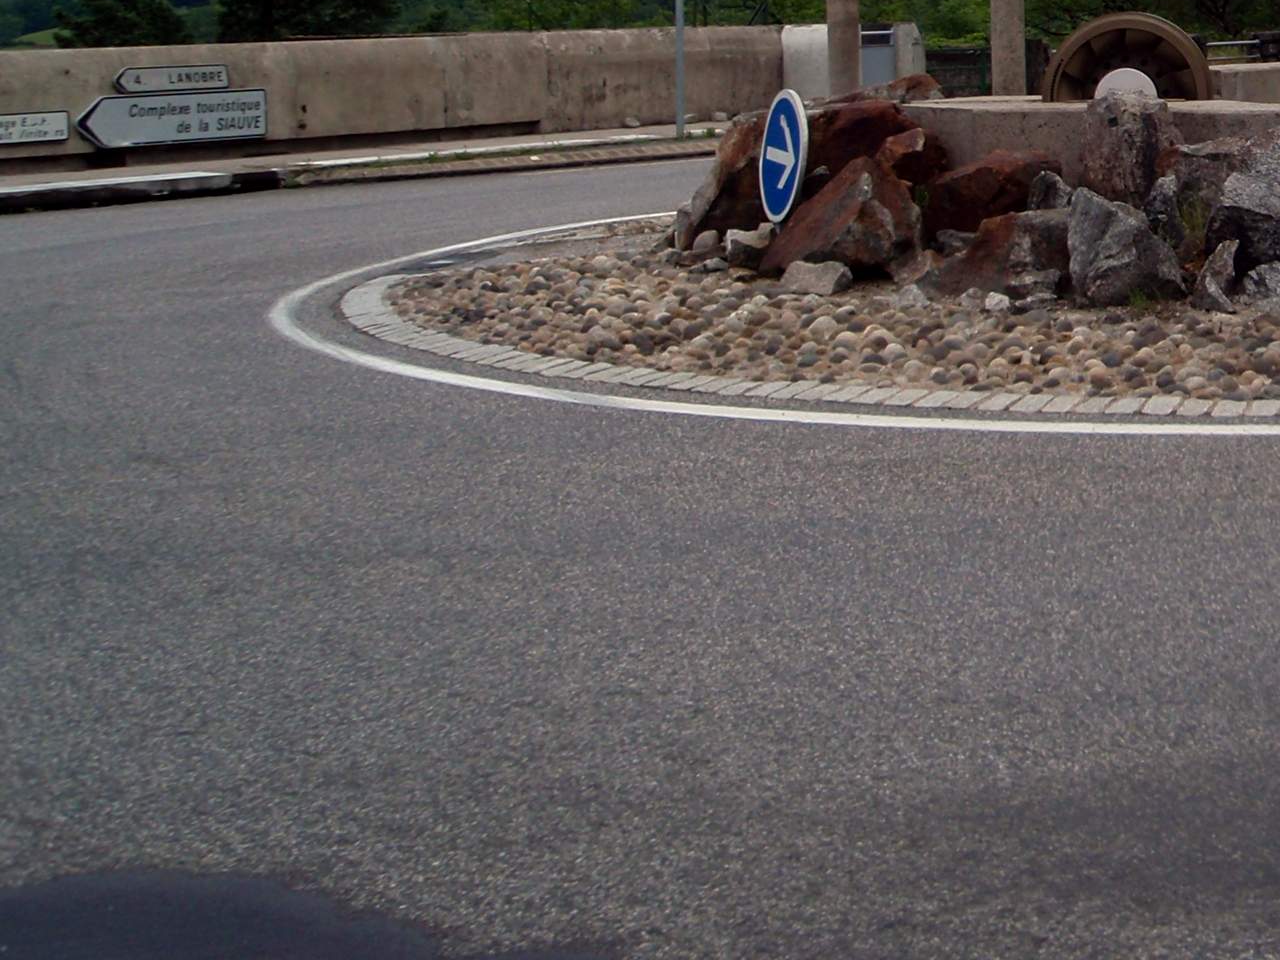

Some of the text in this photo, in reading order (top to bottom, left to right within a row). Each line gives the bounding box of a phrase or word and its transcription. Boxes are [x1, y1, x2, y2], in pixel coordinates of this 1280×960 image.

[167, 71, 224, 85] LANOBRE
[128, 99, 261, 120] Complexe touristique
[176, 115, 262, 134] de la SIAUVE
